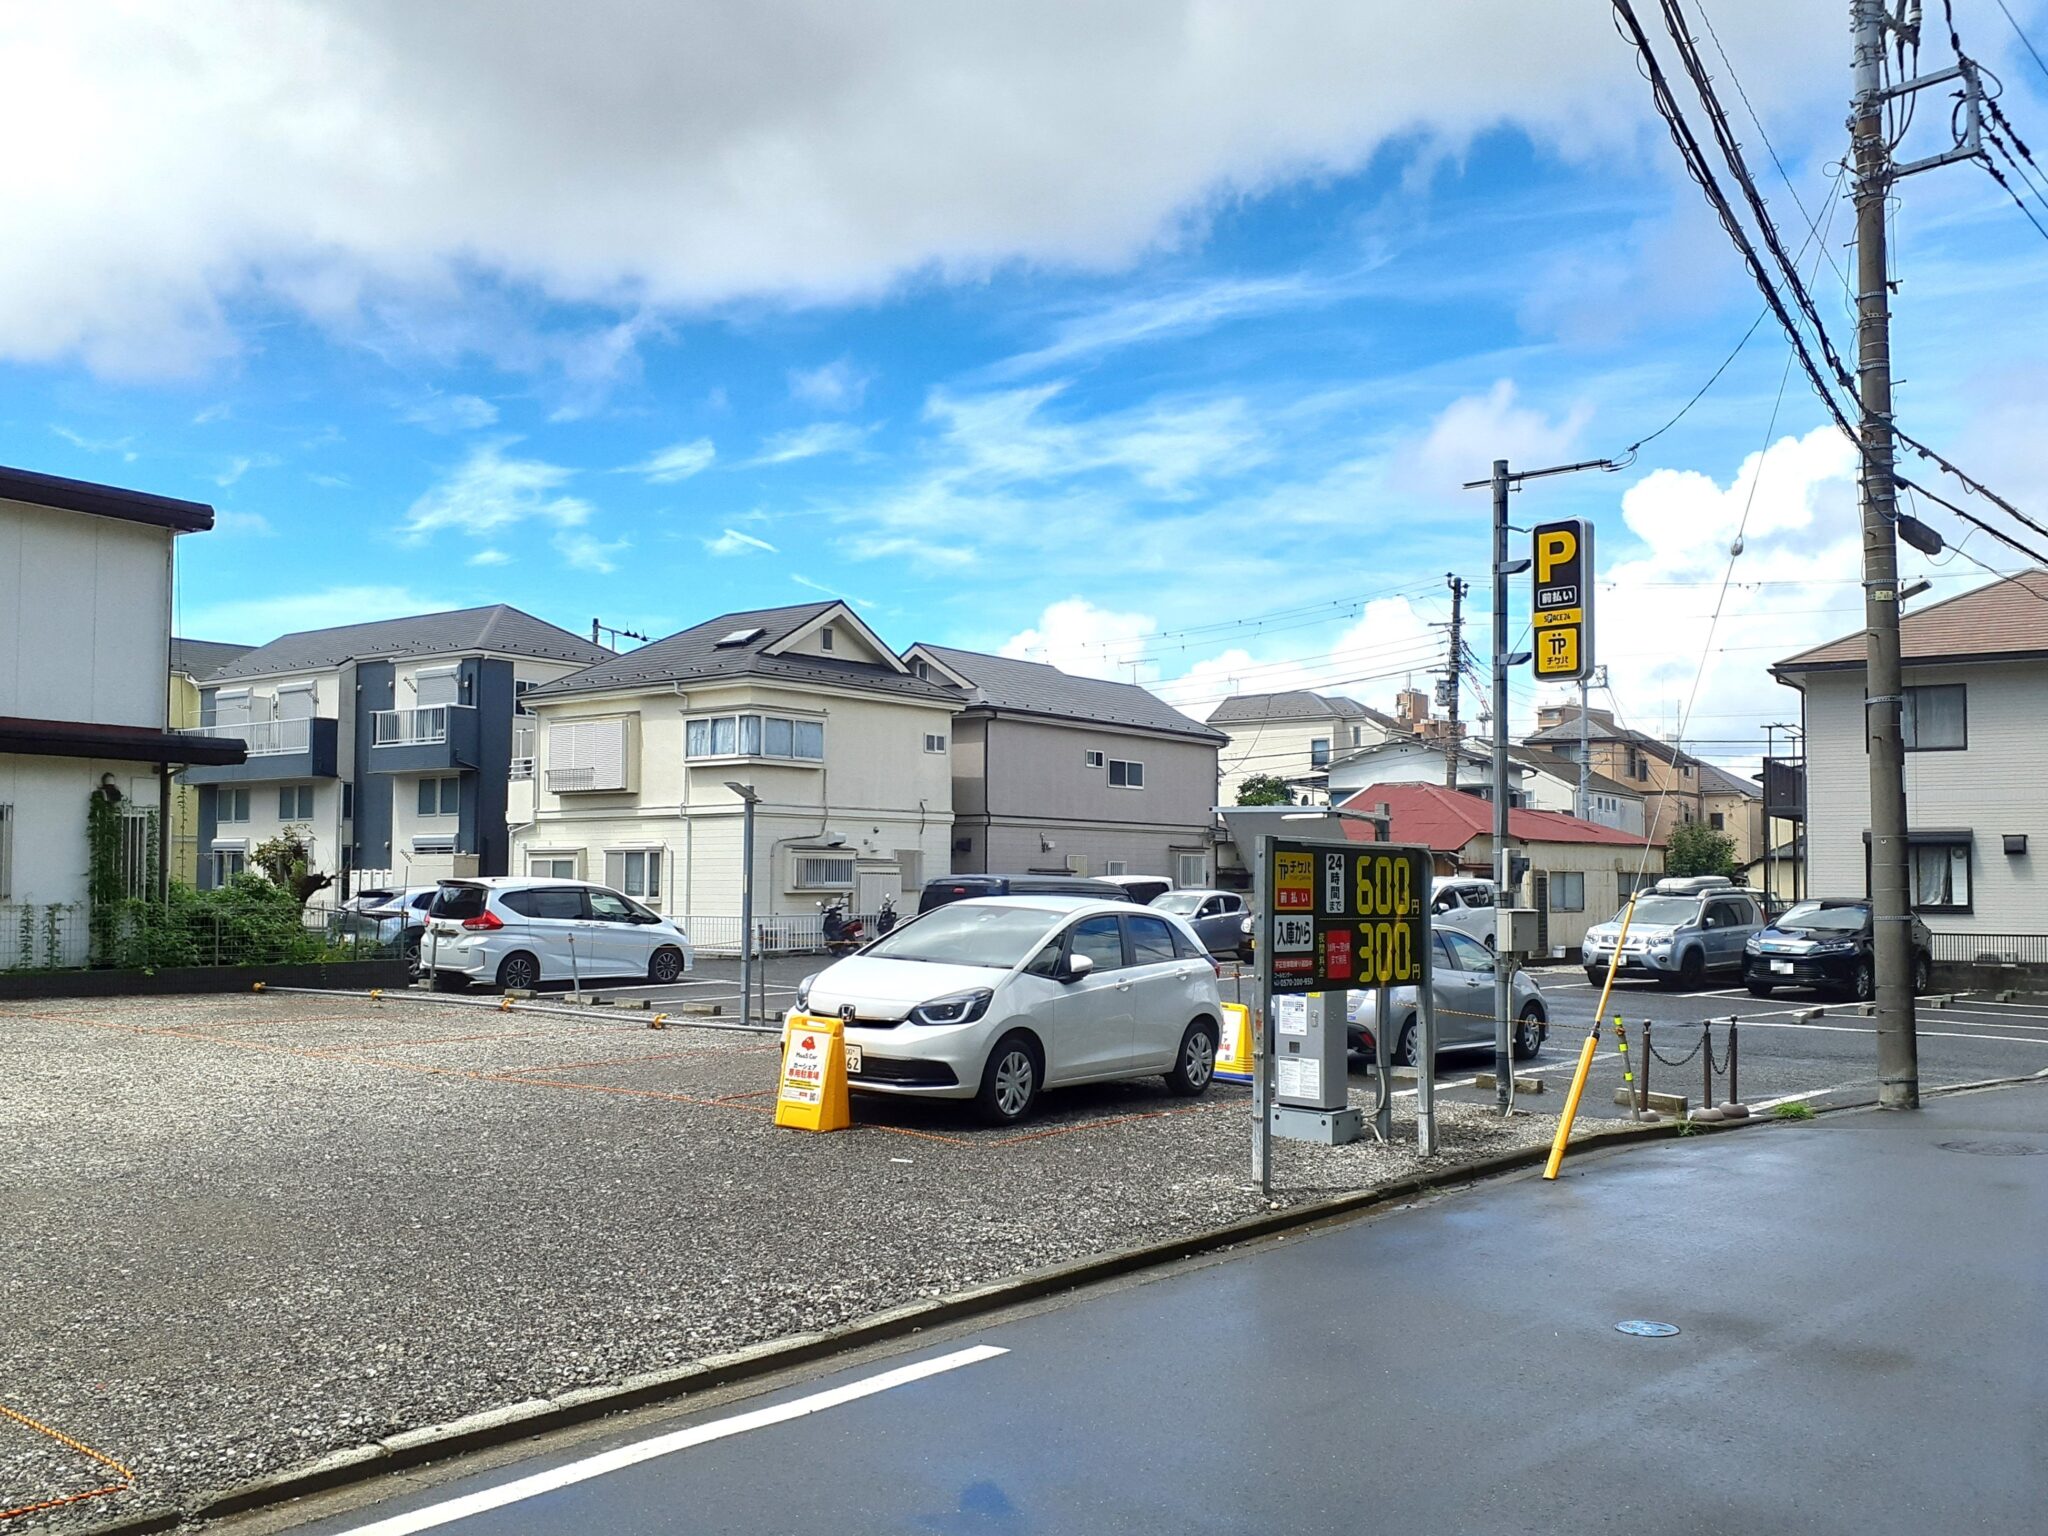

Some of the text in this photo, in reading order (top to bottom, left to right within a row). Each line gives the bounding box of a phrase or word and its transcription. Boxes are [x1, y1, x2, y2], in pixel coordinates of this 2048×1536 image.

[1538, 530, 1577, 584] P
[1541, 590, 1573, 604] 前払い
[1546, 656, 1569, 665] チケパ
[1289, 860, 1312, 874] チケパ
[1280, 891, 1309, 904] 前払い
[1277, 921, 1311, 946] 入庫から
